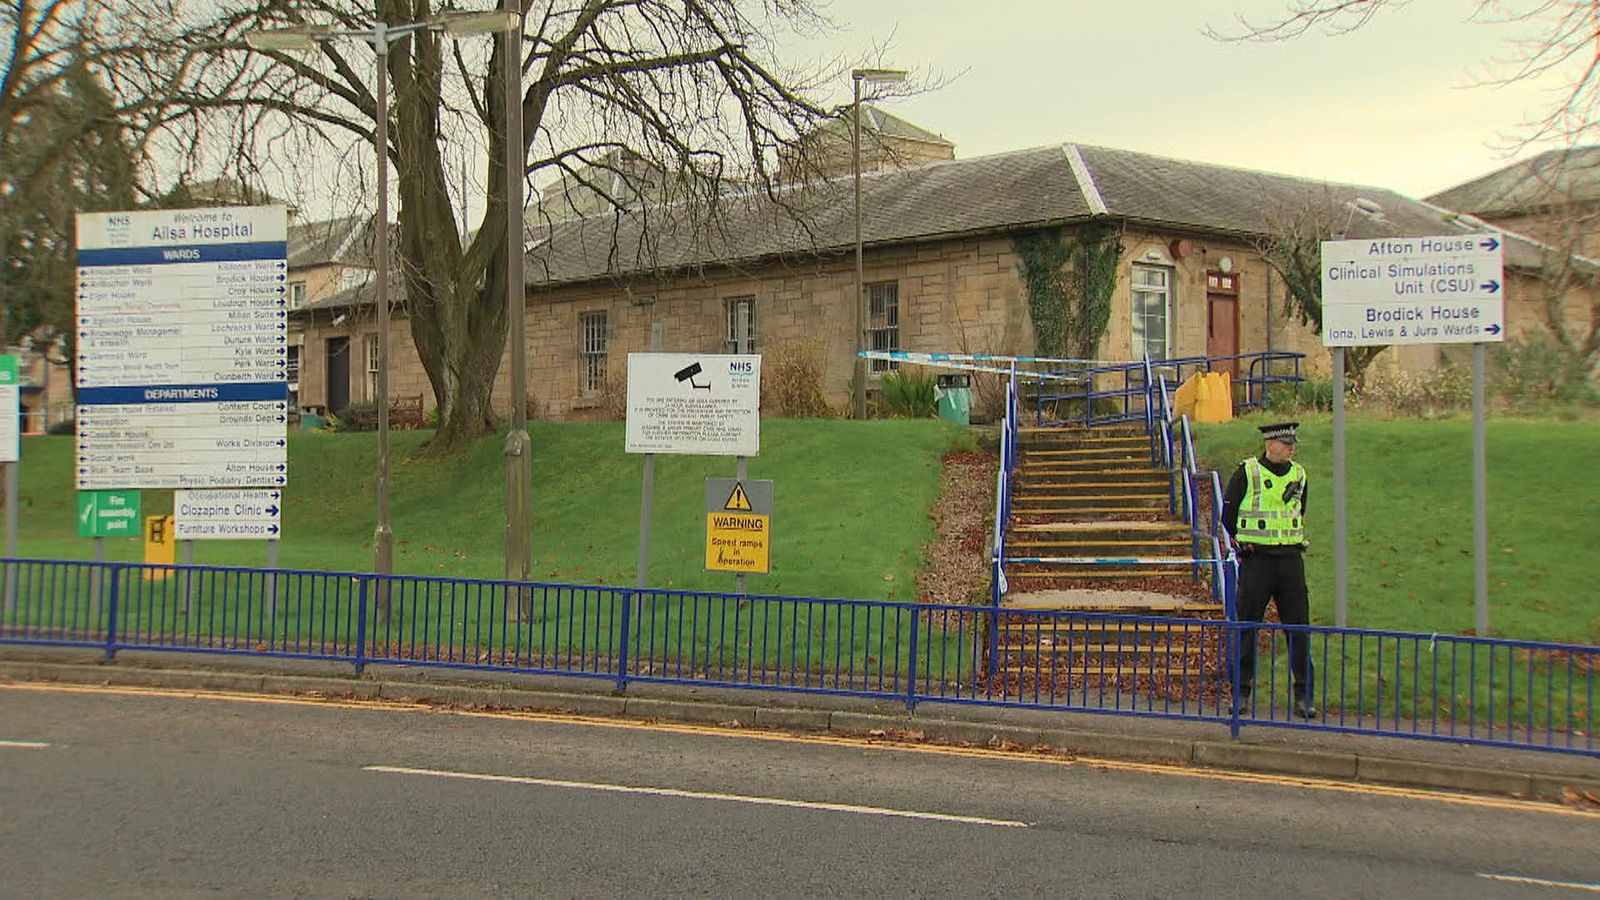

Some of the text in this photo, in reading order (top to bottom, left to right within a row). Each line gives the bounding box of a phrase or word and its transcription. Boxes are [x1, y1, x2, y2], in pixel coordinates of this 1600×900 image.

[109, 216, 130, 226] NHS
[222, 212, 232, 221] to
[153, 222, 253, 240] Ailsa Hospital
[1368, 239, 1473, 255] Afton House
[163, 249, 200, 260] WARDS
[1328, 263, 1474, 280] Clinical Simulations
[250, 273, 275, 282] House
[250, 286, 275, 294] House
[1394, 279, 1475, 295] Unit (CSU)
[250, 299, 275, 307] House
[1366, 305, 1480, 322] Brodick House
[255, 322, 275, 331] Ward
[1329, 322, 1480, 340] Iona, Lewis & Jura Wards
[255, 335, 275, 343] Ward
[255, 347, 275, 355] Ward
[255, 359, 275, 367] Ward
[730, 362, 752, 372] NHS
[255, 371, 275, 380] Ward
[144, 388, 219, 399] DEPARTMENTS
[252, 402, 275, 410] Court
[256, 414, 275, 423] Dept
[216, 439, 275, 447] Works Division
[249, 462, 275, 471] House
[243, 490, 269, 499] Health
[180, 503, 262, 517] Clozapine Clinic
[714, 517, 763, 529] WARNING
[179, 522, 265, 534] Furniture Workshops
[712, 537, 763, 548] Speed ramps
[733, 548, 740, 556] in
